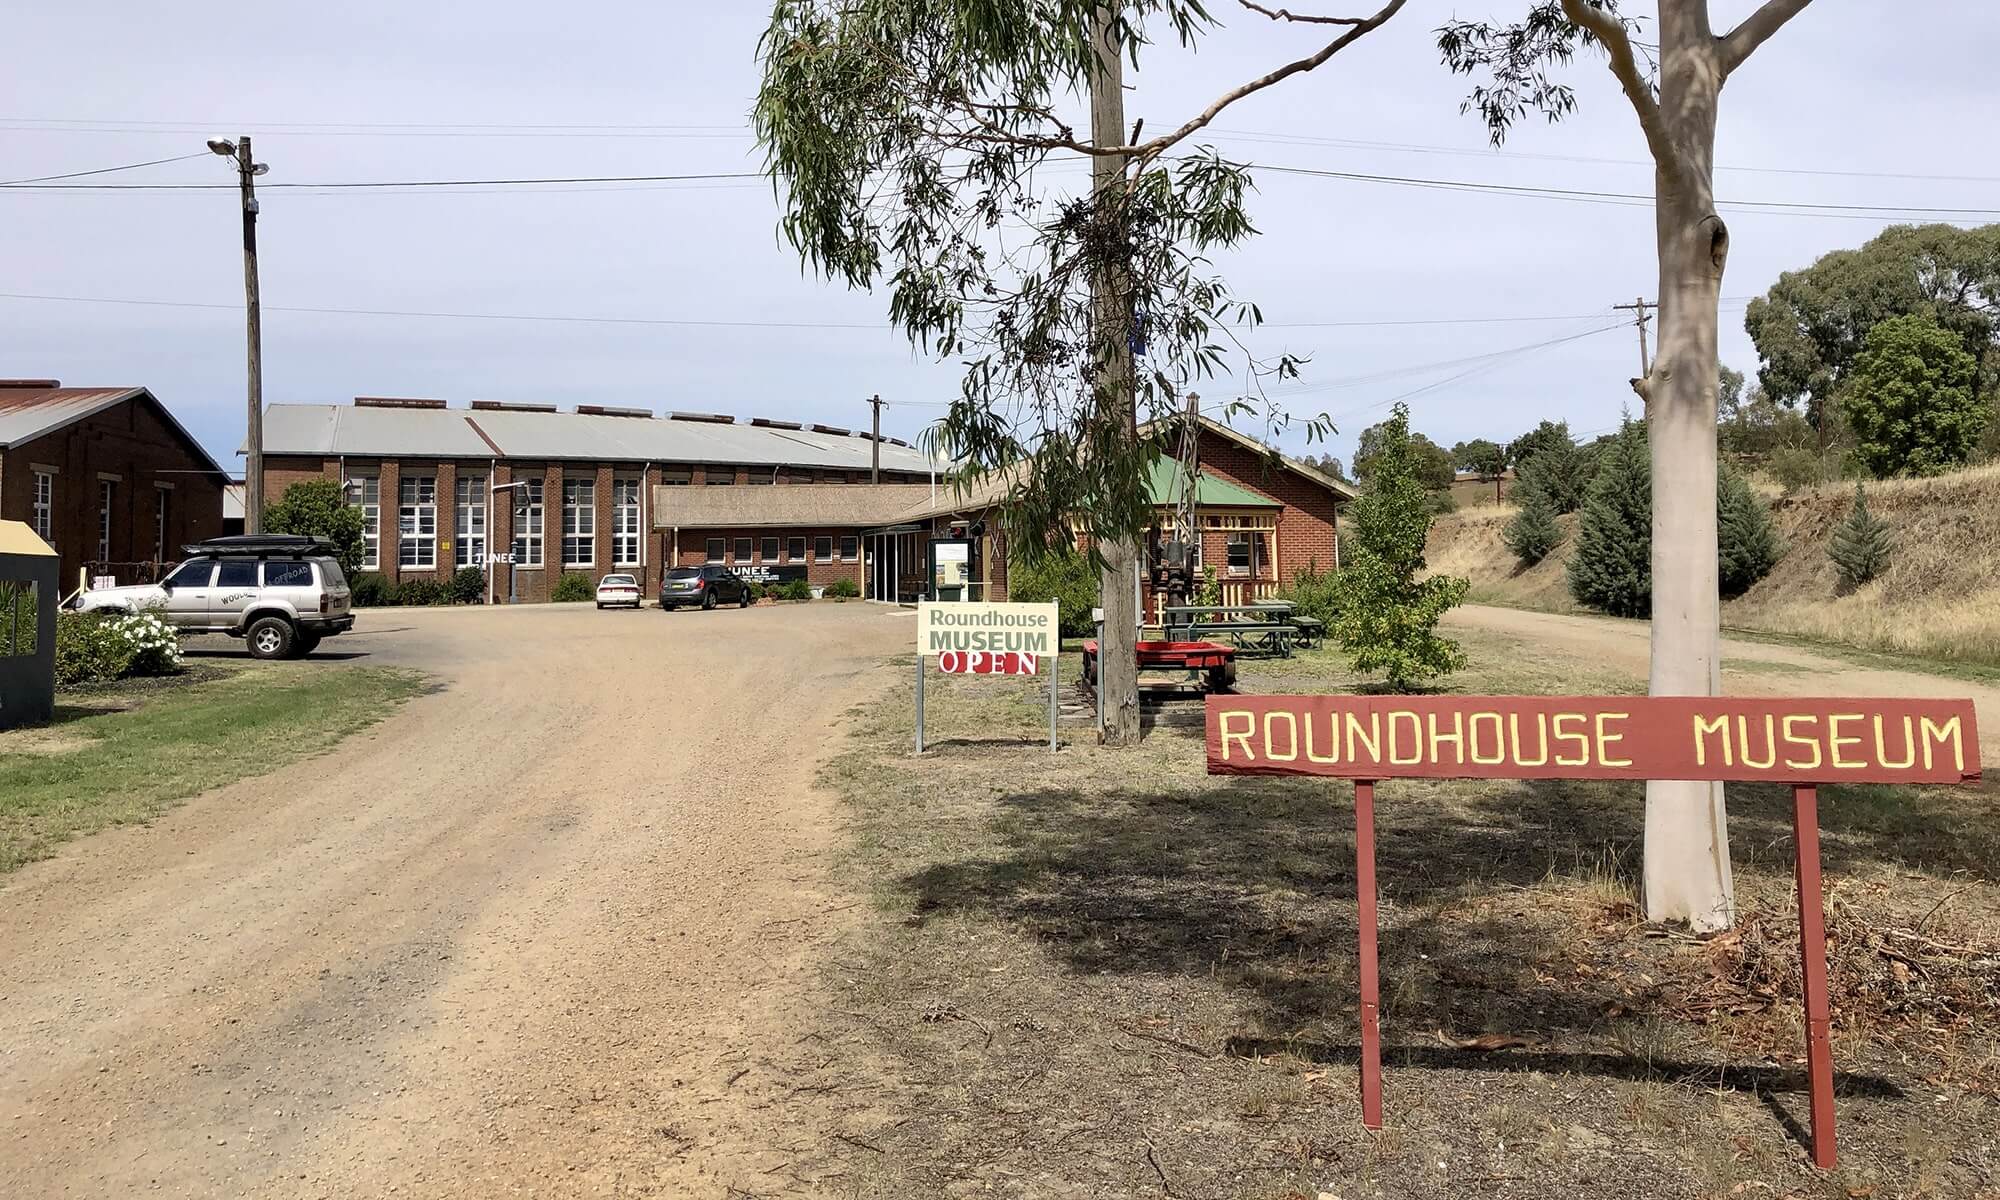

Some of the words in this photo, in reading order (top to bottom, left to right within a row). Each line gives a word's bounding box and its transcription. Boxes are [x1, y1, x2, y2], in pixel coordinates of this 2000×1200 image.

[930, 609, 1048, 627] Roundhouse
[929, 630, 1048, 652] MUSEUM
[939, 651, 1038, 675] OPEN
[1218, 710, 1633, 766] ROUNDHOUSE
[1693, 713, 1965, 771] MUSEUM
